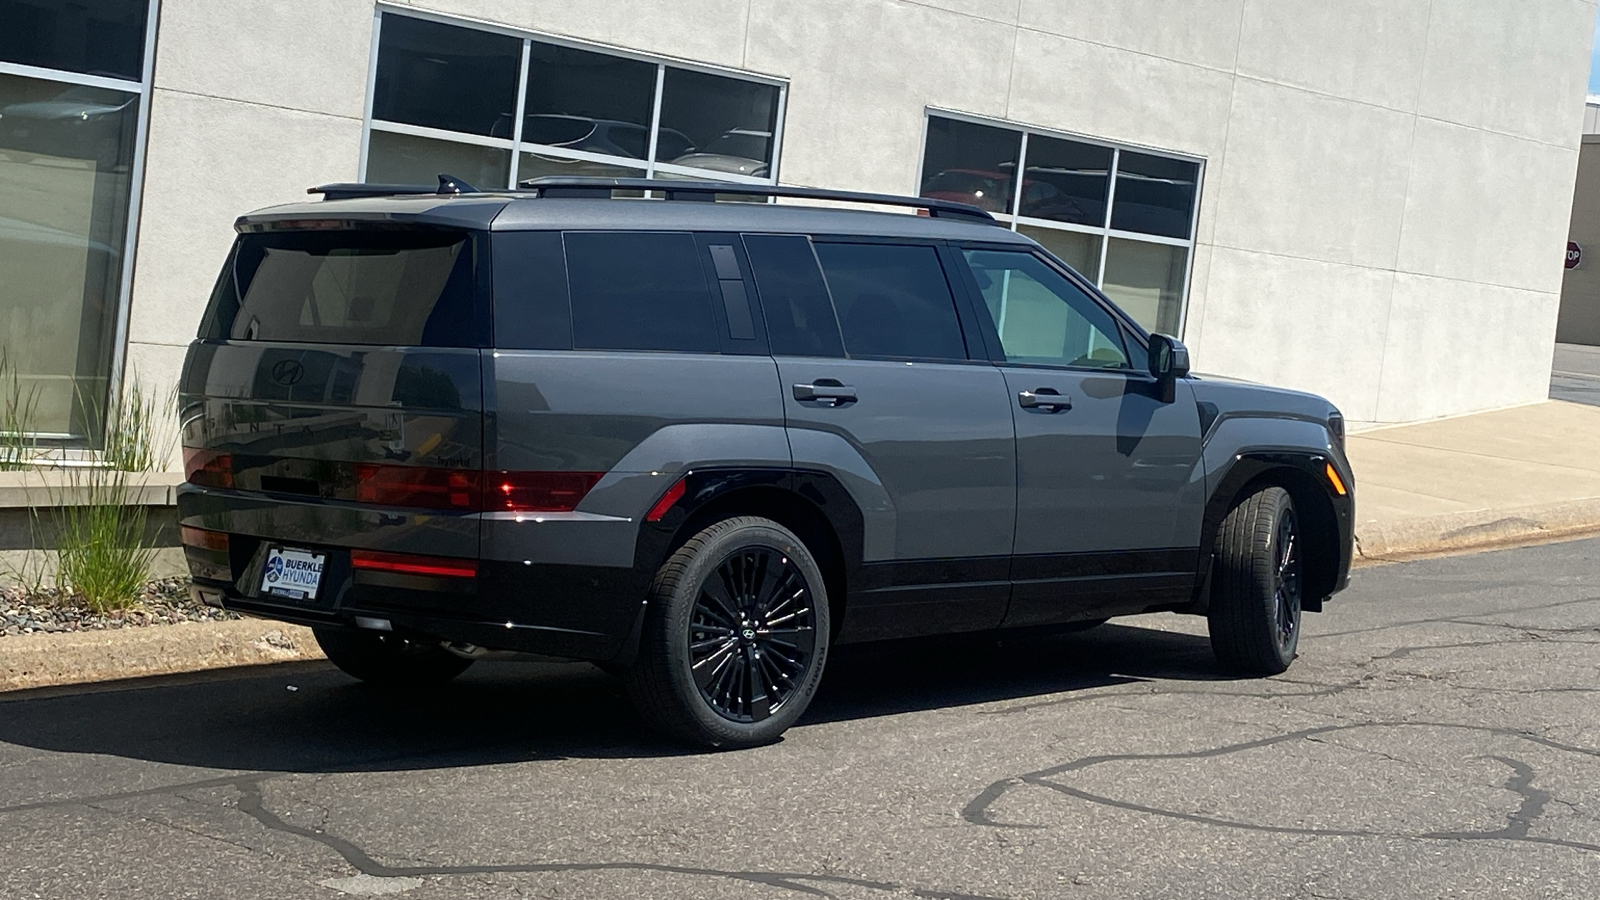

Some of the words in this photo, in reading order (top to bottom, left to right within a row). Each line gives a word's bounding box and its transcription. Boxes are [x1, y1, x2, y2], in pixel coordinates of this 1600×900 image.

[437, 455, 471, 467] hybrid
[285, 558, 324, 572] BUERKLE
[282, 569, 318, 585] HYUNDA
[805, 647, 825, 696] KUMHO
